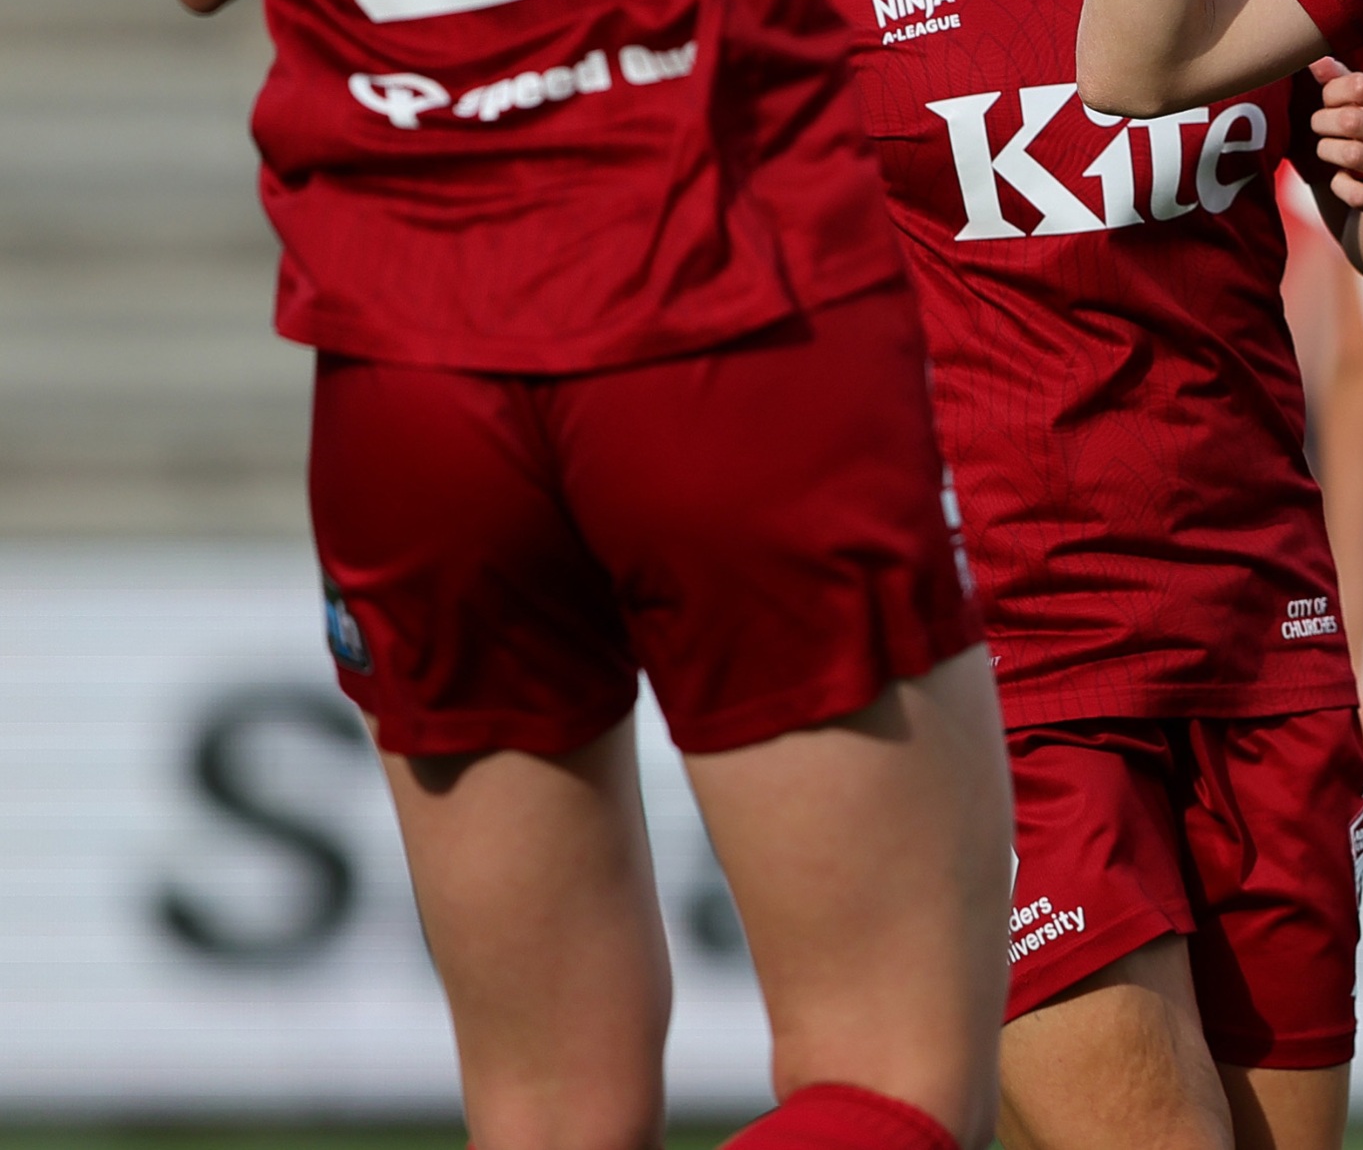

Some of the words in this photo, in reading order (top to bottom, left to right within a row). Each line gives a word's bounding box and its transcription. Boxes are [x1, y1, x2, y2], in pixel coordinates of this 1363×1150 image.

[882, 13, 962, 47] A-LEAGUE
[925, 81, 1268, 241] Kite
[1287, 598, 1313, 619] CITY
[1313, 596, 1328, 615] OF
[1281, 615, 1338, 640] CHURCHES
[1008, 896, 1053, 936] ders
